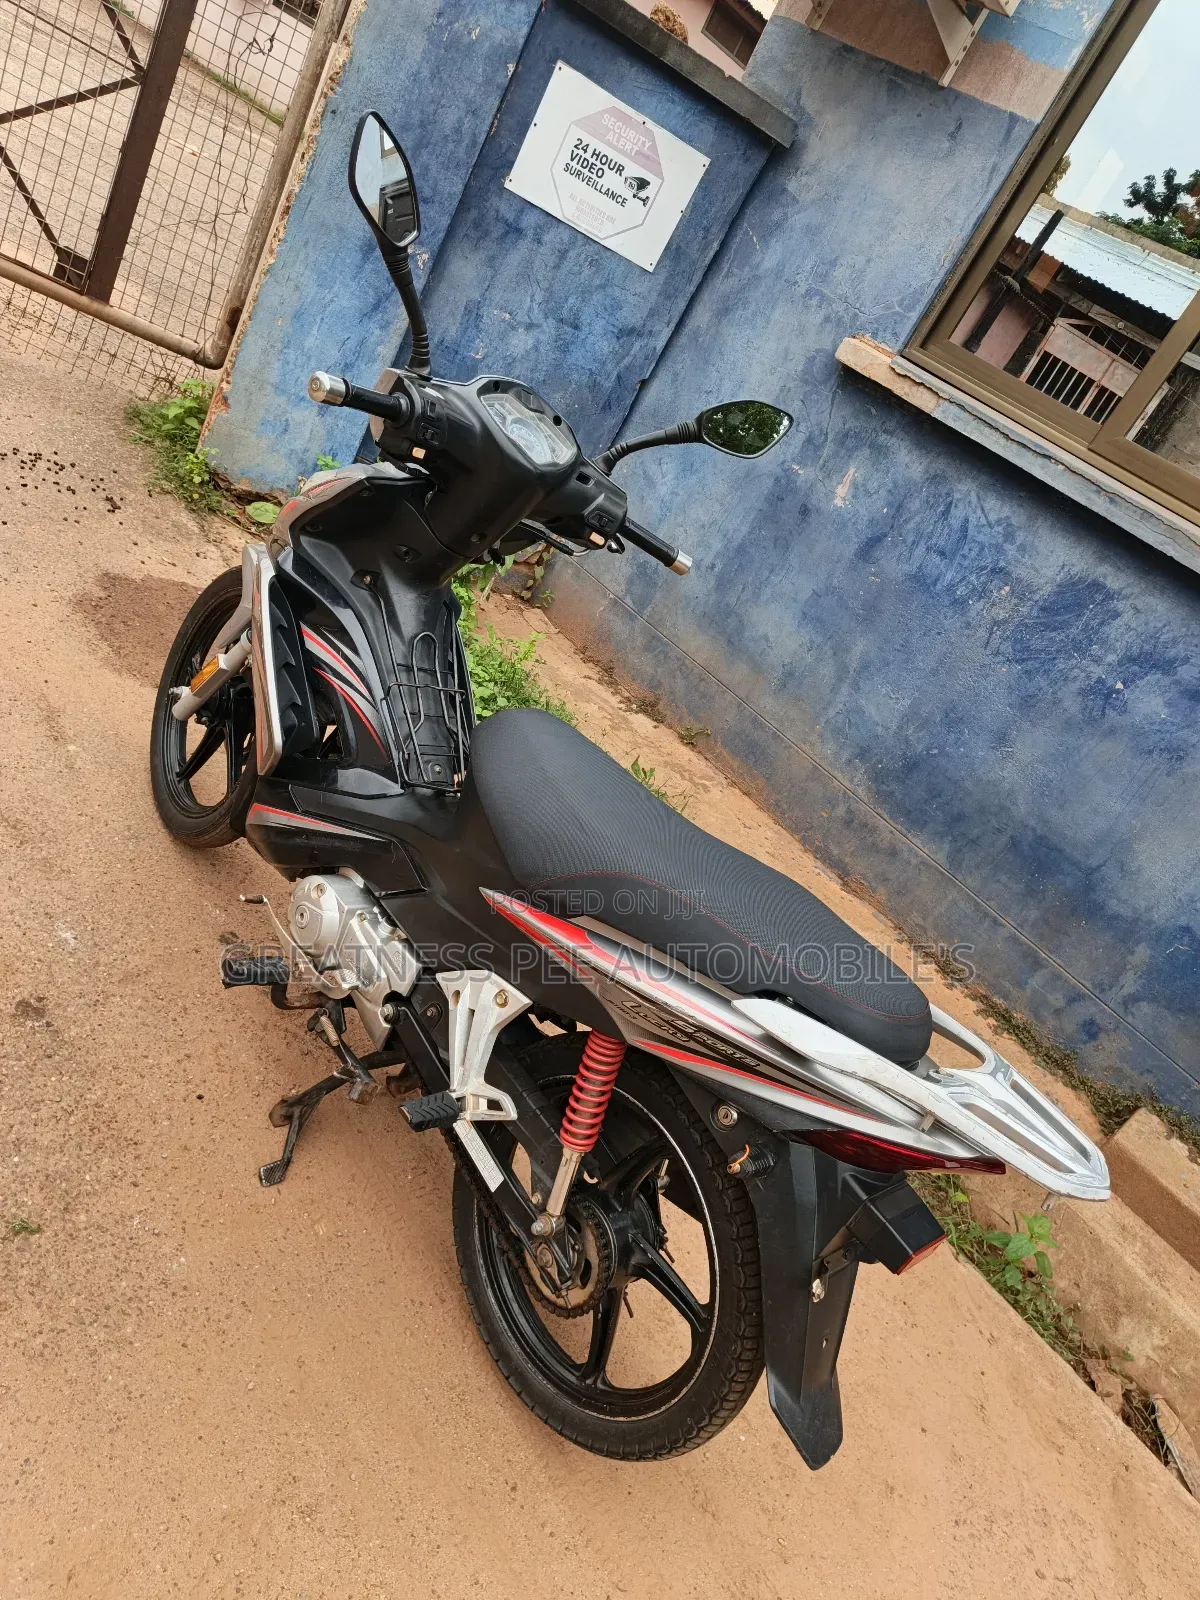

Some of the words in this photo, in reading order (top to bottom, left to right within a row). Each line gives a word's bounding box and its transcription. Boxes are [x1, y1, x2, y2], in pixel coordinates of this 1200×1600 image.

[601, 114, 652, 151] SECURITY
[605, 131, 639, 156] ALERT
[569, 150, 605, 179] VIDEO
[573, 138, 590, 154] 24
[590, 148, 625, 177] HOUR
[563, 163, 629, 207] SURVEILLANCE
